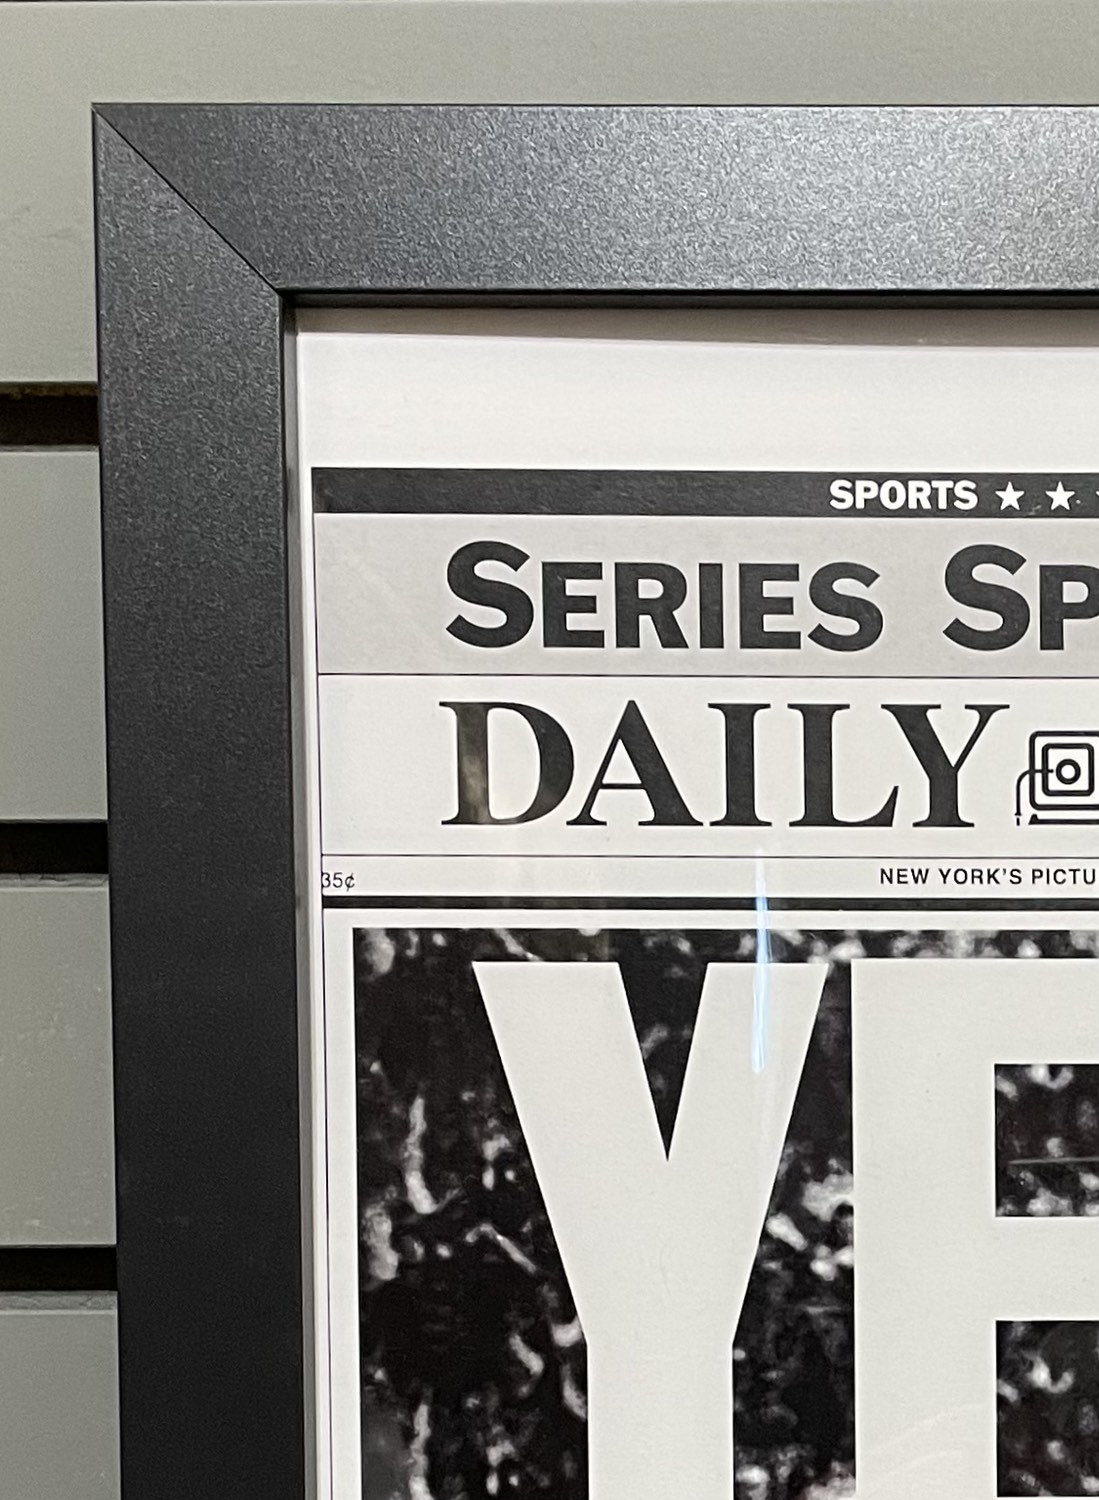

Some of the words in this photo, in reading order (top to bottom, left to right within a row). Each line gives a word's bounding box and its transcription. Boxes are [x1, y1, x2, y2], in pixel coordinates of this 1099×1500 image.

[829, 479, 978, 510] SPORTS
[438, 699, 1010, 828] DAILY
[322, 871, 356, 892] 35¢
[880, 867, 930, 885] NEW
[938, 867, 1023, 885] YORK’S
